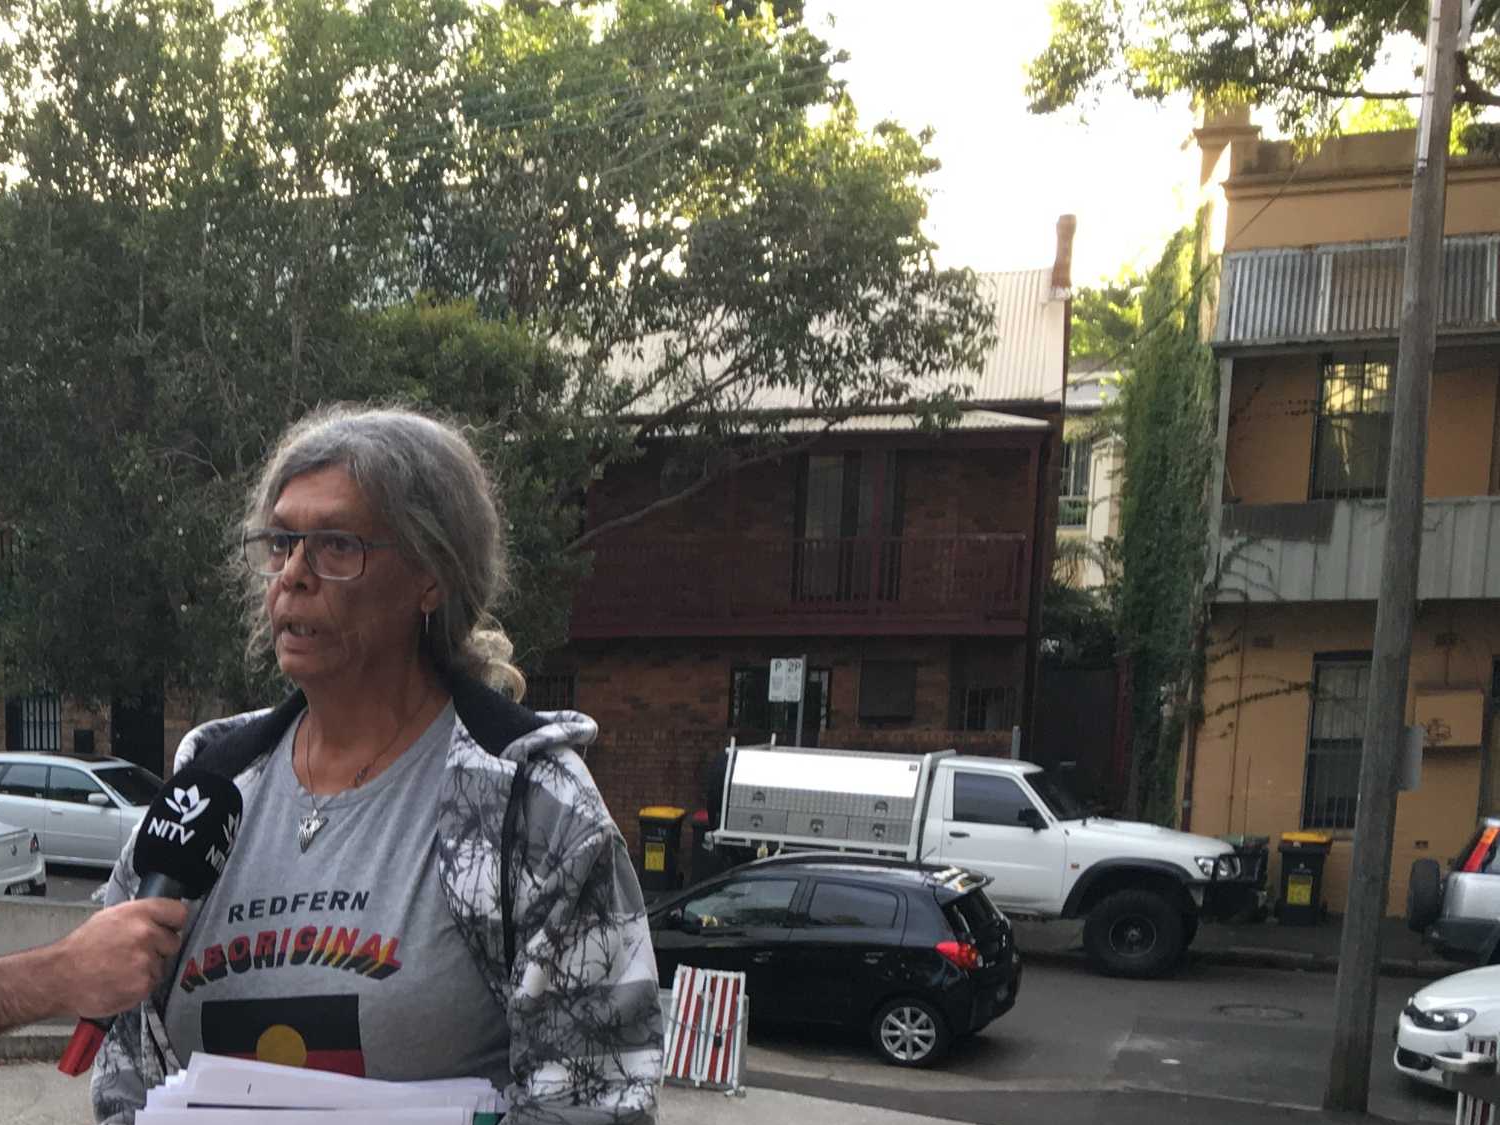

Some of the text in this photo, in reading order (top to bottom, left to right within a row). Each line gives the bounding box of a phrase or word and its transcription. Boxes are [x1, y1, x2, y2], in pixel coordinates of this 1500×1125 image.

[147, 816, 196, 846] NITV
[228, 890, 369, 924] REDFERN
[180, 924, 403, 991] ABORIGINAL
